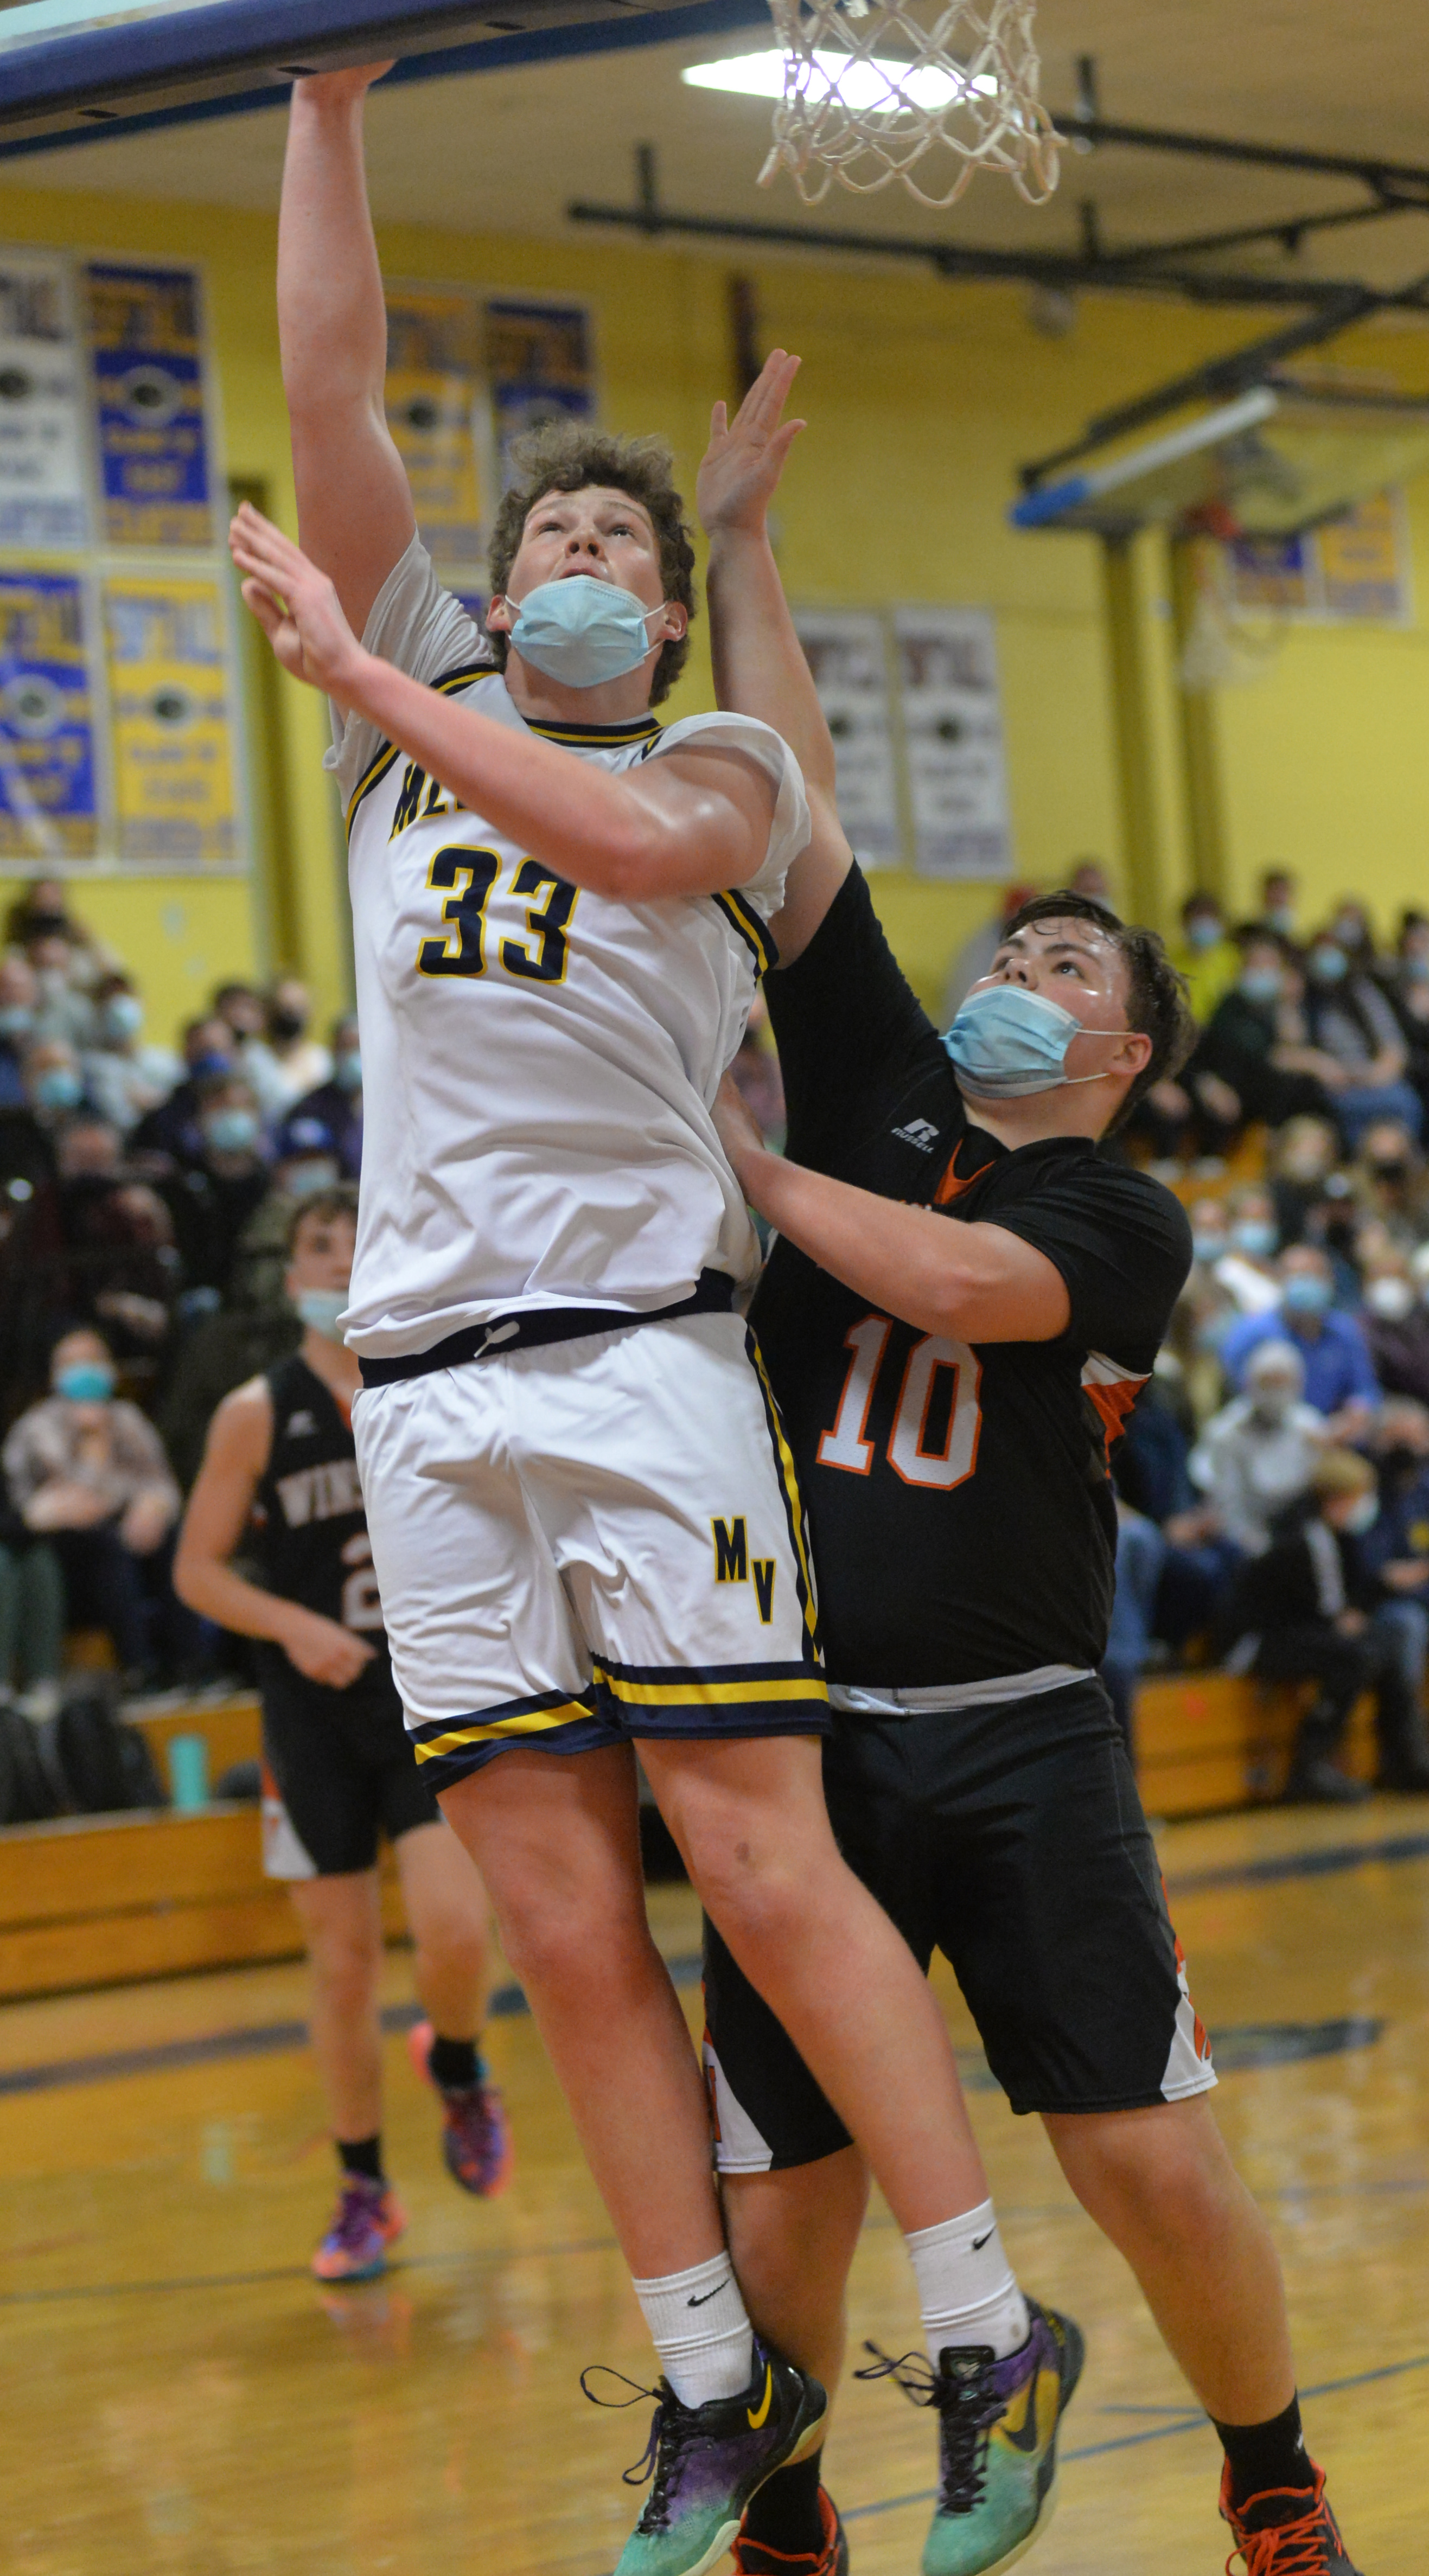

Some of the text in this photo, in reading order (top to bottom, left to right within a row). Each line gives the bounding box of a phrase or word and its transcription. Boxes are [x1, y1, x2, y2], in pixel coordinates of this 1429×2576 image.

[414, 843, 582, 986] 33
[890, 1127, 935, 1154] RUSSELL
[815, 1313, 983, 1491] 10
